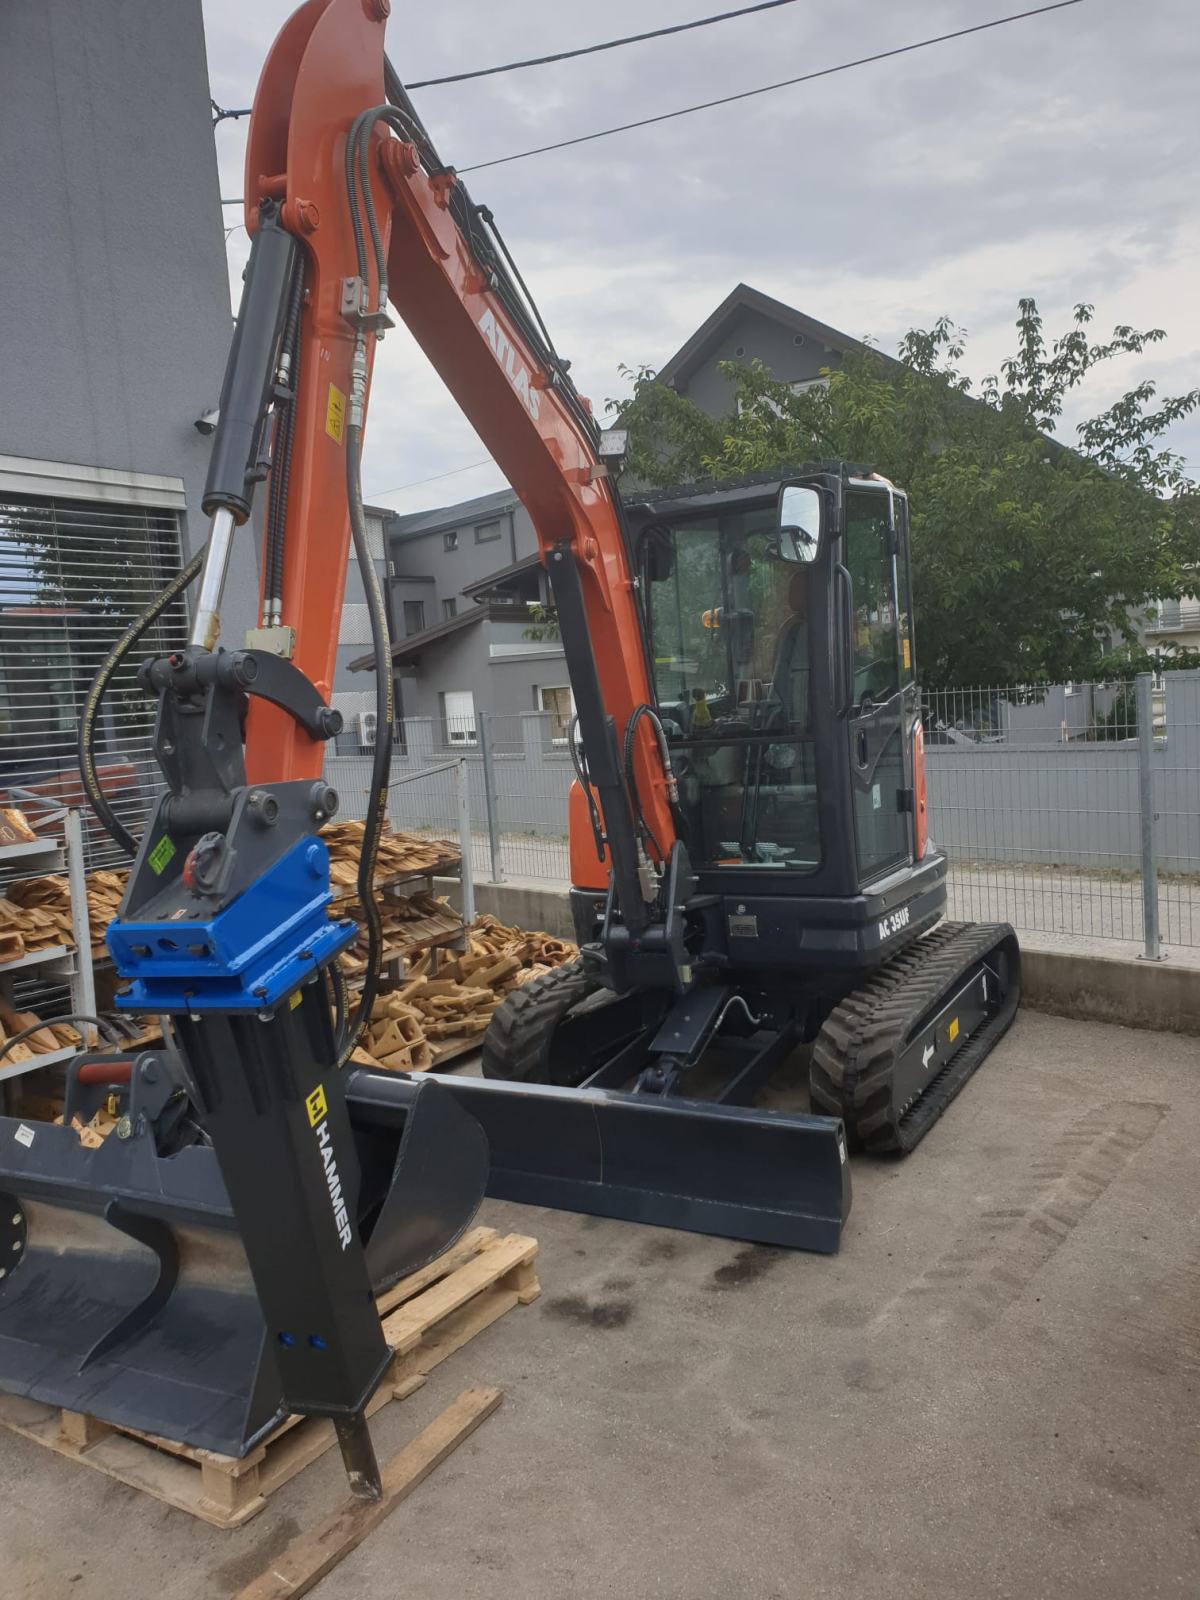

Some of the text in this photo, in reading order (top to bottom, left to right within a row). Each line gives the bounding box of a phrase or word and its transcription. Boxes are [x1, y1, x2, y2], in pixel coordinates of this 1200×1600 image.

[478, 307, 540, 421] ATLAS
[878, 906, 910, 940] AC 35UF
[316, 1120, 352, 1252] HAMMER
